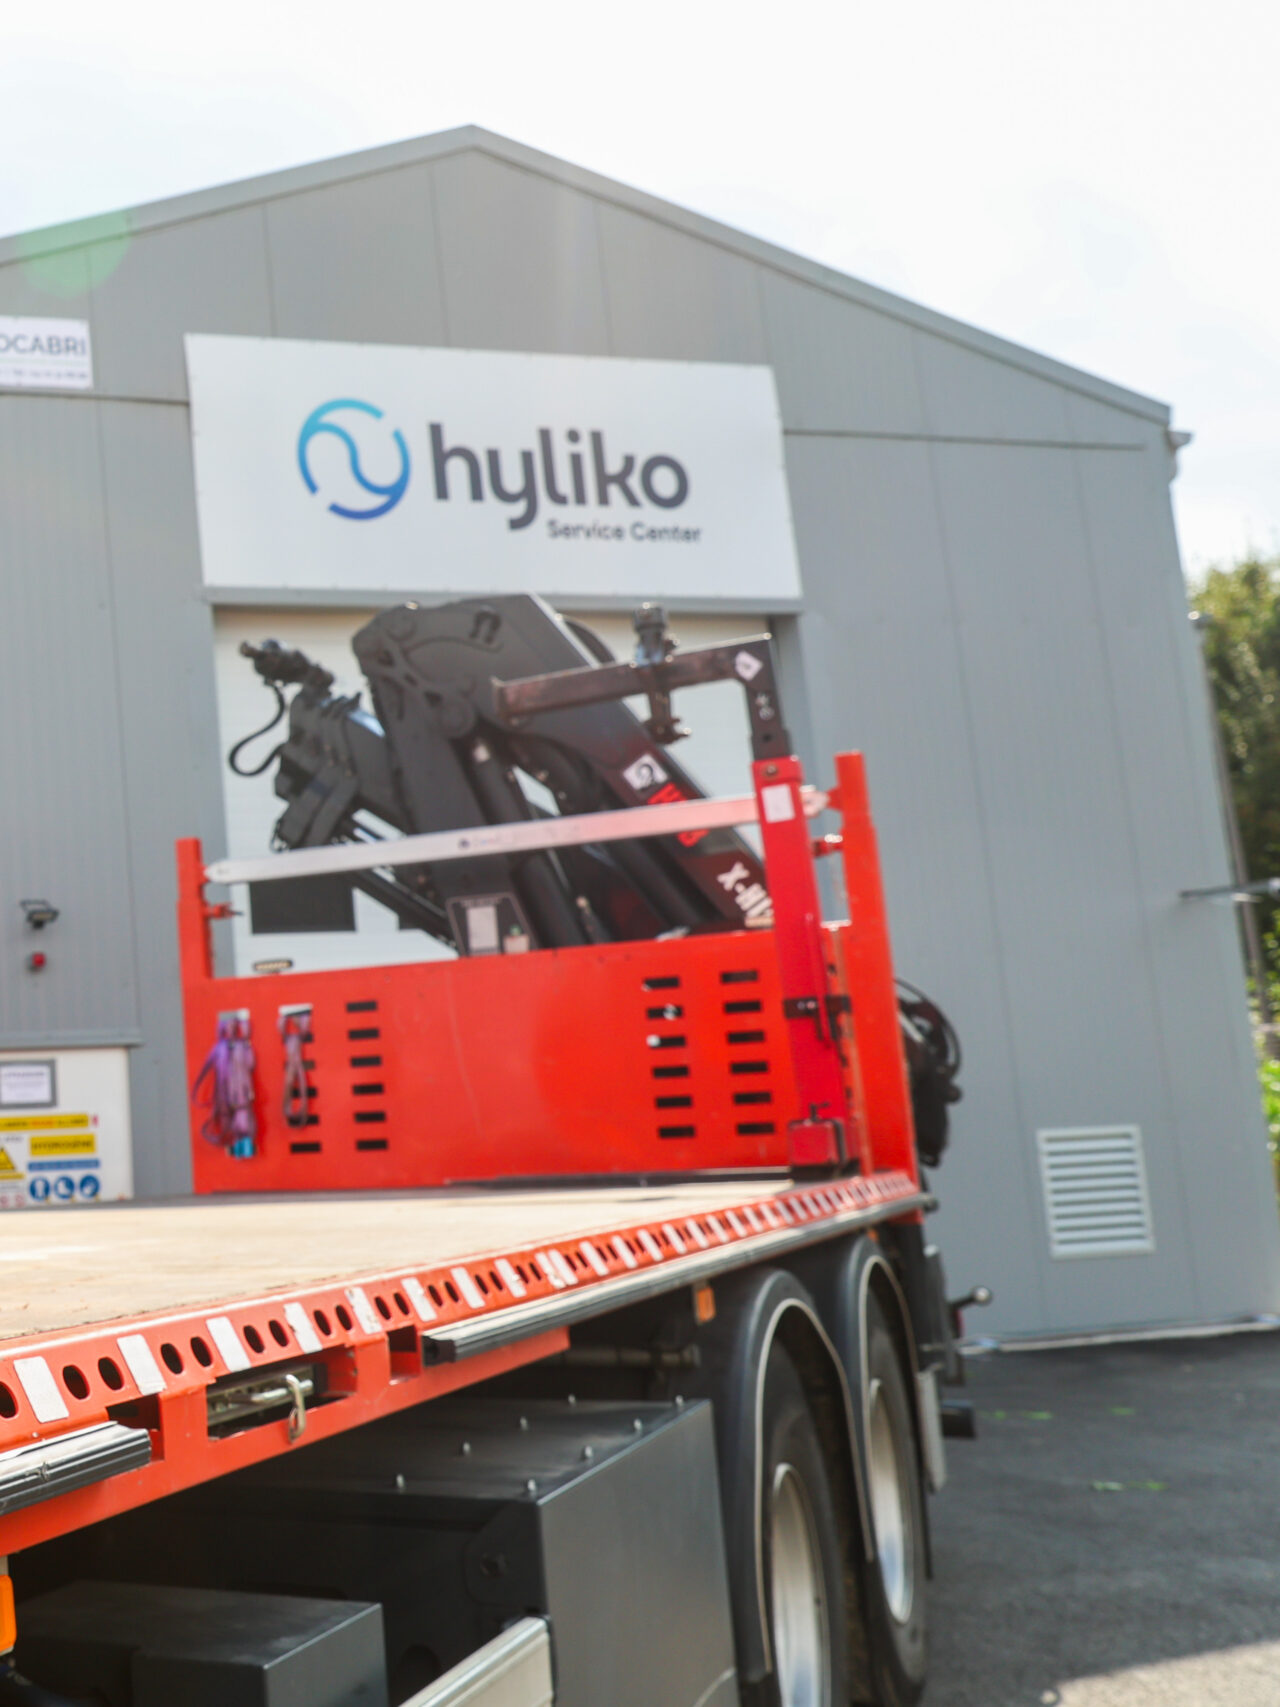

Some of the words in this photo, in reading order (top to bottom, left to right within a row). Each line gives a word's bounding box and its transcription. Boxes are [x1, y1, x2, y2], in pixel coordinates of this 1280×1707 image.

[428, 422, 689, 531] hyliko
[547, 518, 624, 541] Service
[631, 521, 701, 544] Center
